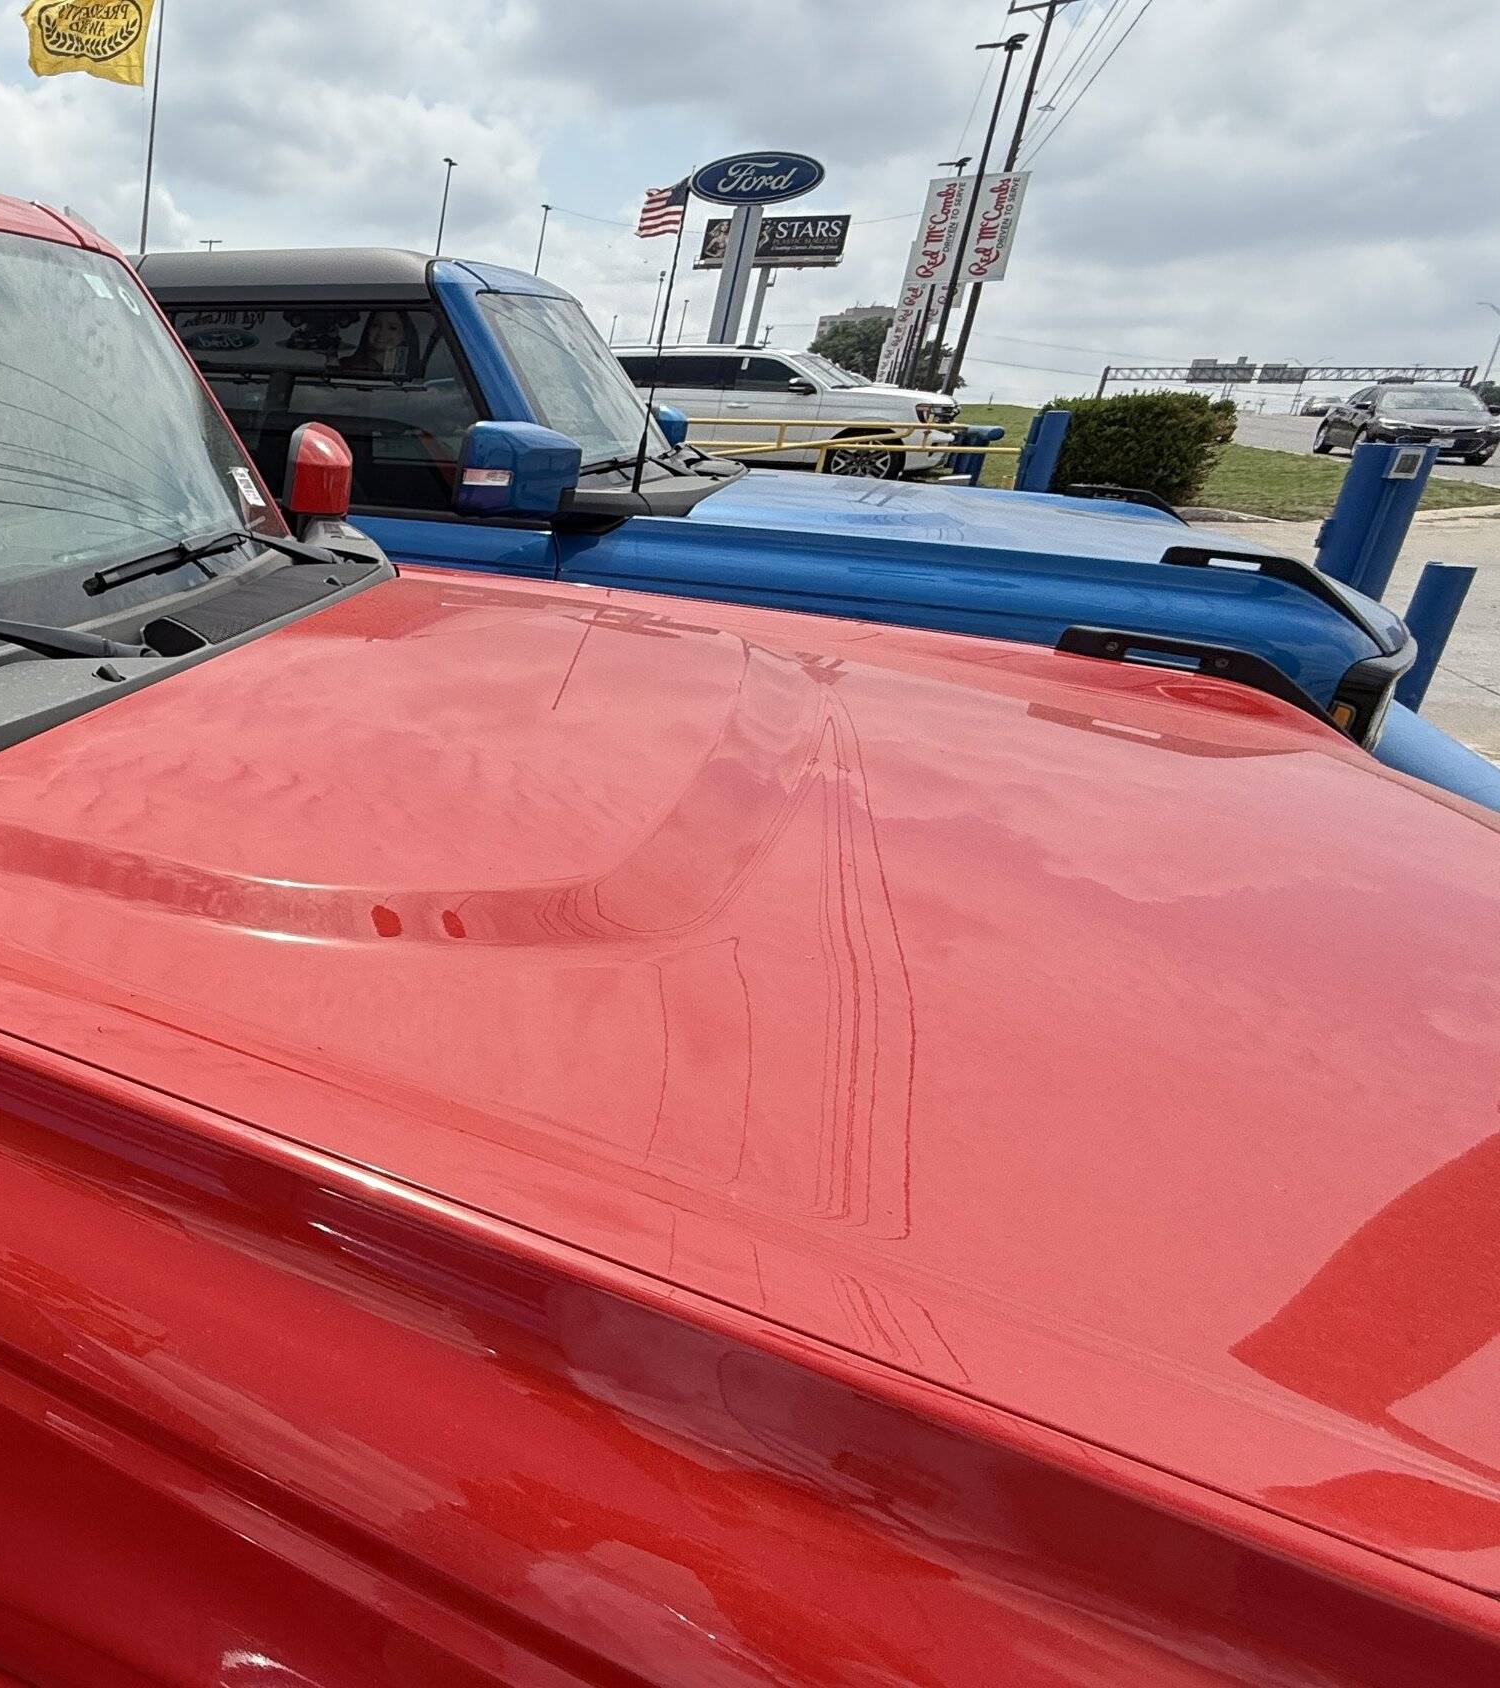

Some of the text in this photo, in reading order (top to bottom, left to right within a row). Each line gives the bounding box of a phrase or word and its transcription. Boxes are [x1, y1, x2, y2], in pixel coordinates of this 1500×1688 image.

[717, 161, 798, 193] Ford
[942, 181, 966, 253] DRIVEN TO SERVE
[995, 177, 1021, 249] DRIVEN TO SERVE
[775, 220, 843, 239] STARS
[915, 250, 947, 279] Red
[968, 247, 1000, 276] Red
